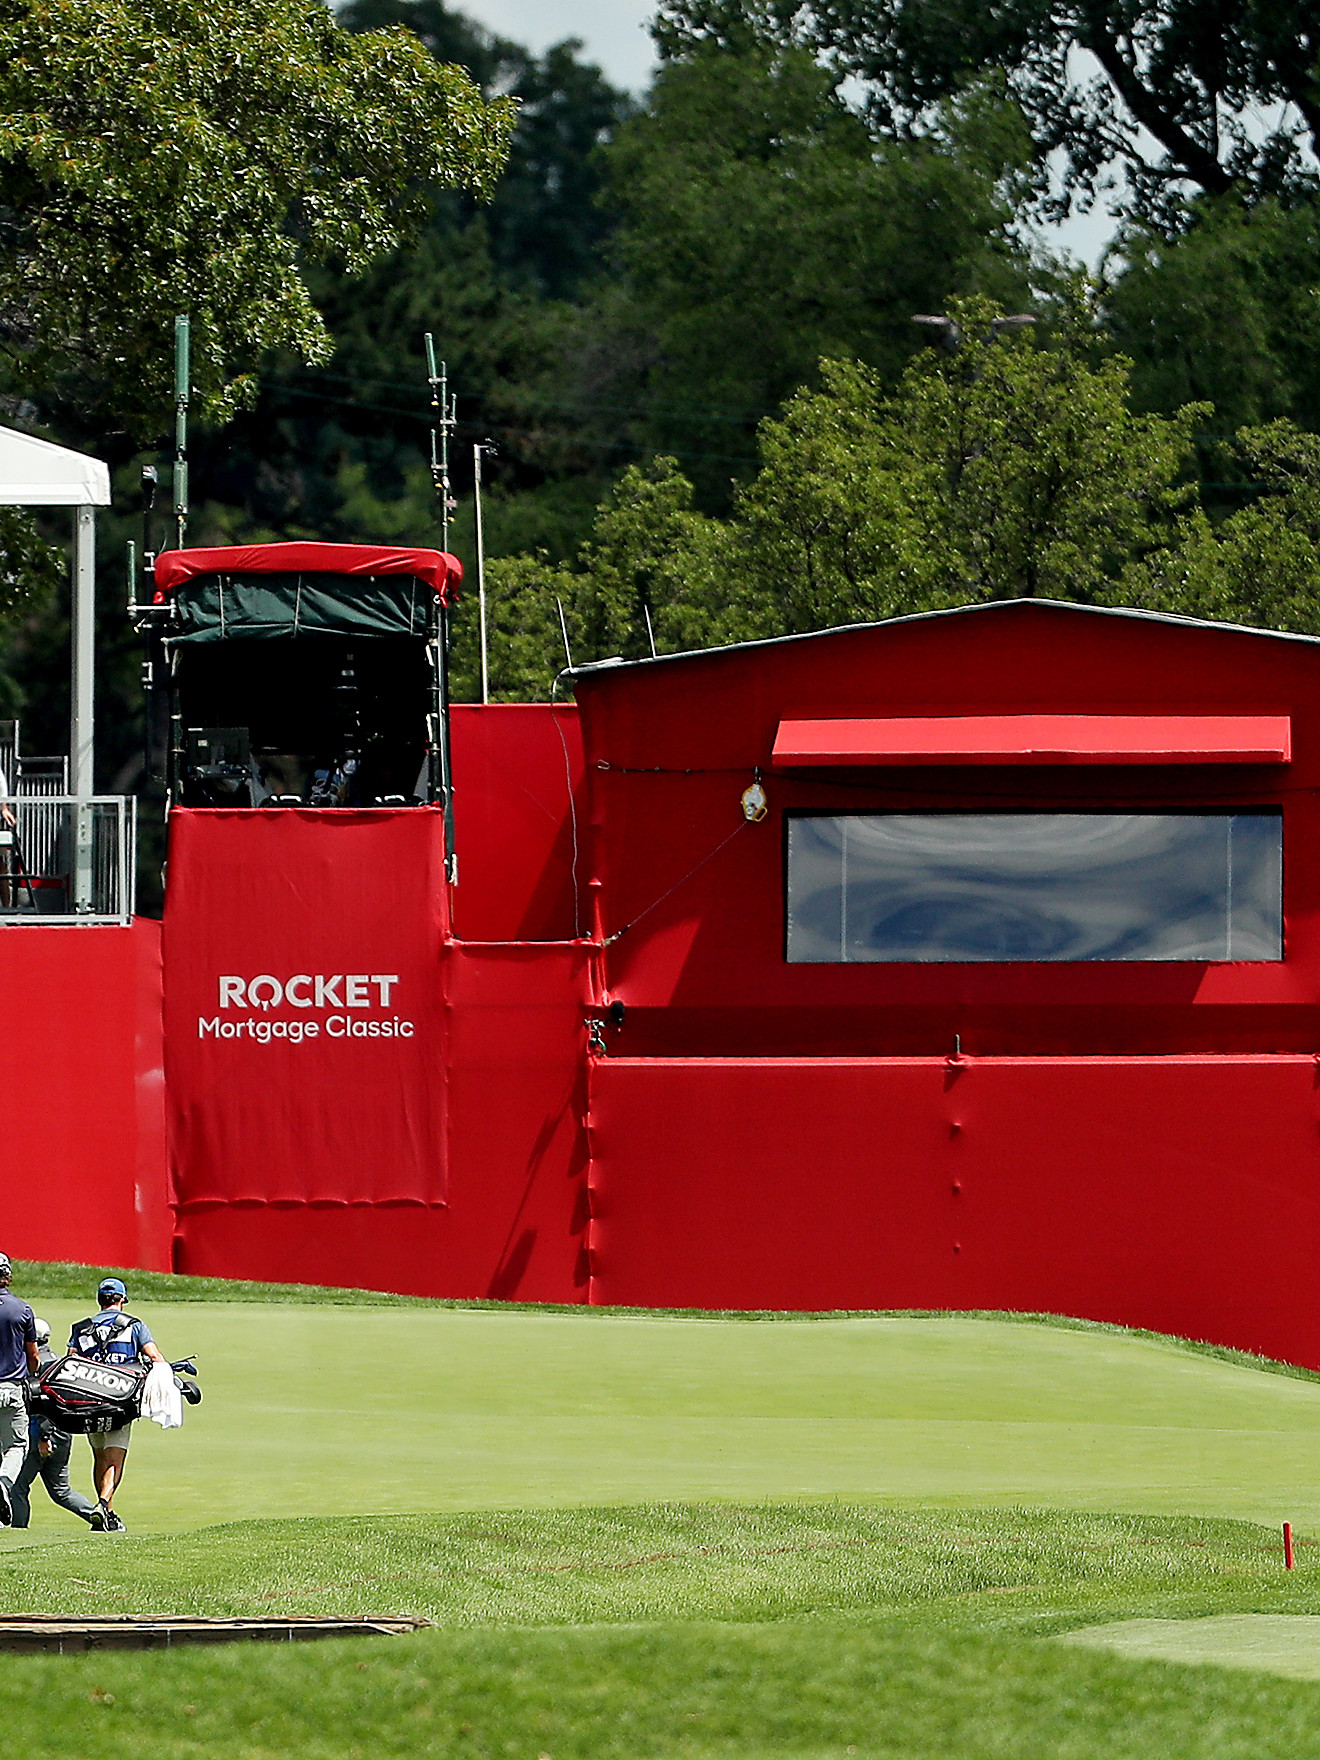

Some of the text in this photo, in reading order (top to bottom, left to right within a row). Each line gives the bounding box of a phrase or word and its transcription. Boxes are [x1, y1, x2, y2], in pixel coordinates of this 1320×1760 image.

[218, 974, 399, 1010] ROCKET
[197, 1014, 415, 1044] Mortgage Classic
[55, 1359, 134, 1393] SRIXON
